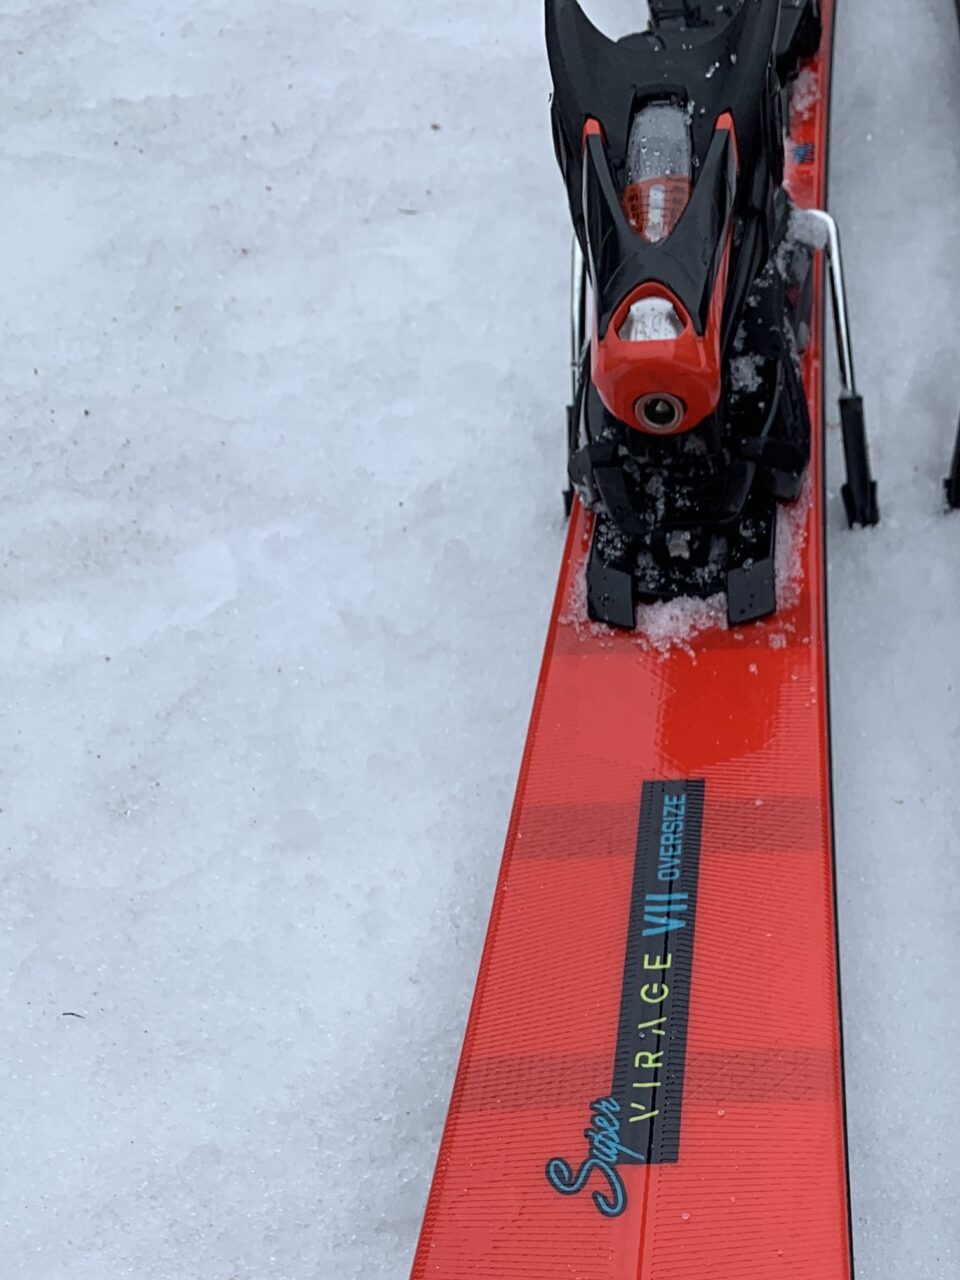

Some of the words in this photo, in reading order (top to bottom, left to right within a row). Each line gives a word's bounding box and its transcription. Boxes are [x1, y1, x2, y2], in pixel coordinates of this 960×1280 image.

[657, 793, 686, 882] OVERSIZE
[642, 892, 689, 937] VII
[629, 952, 672, 1123] VIRAGE
[544, 1096, 646, 1218] Super
